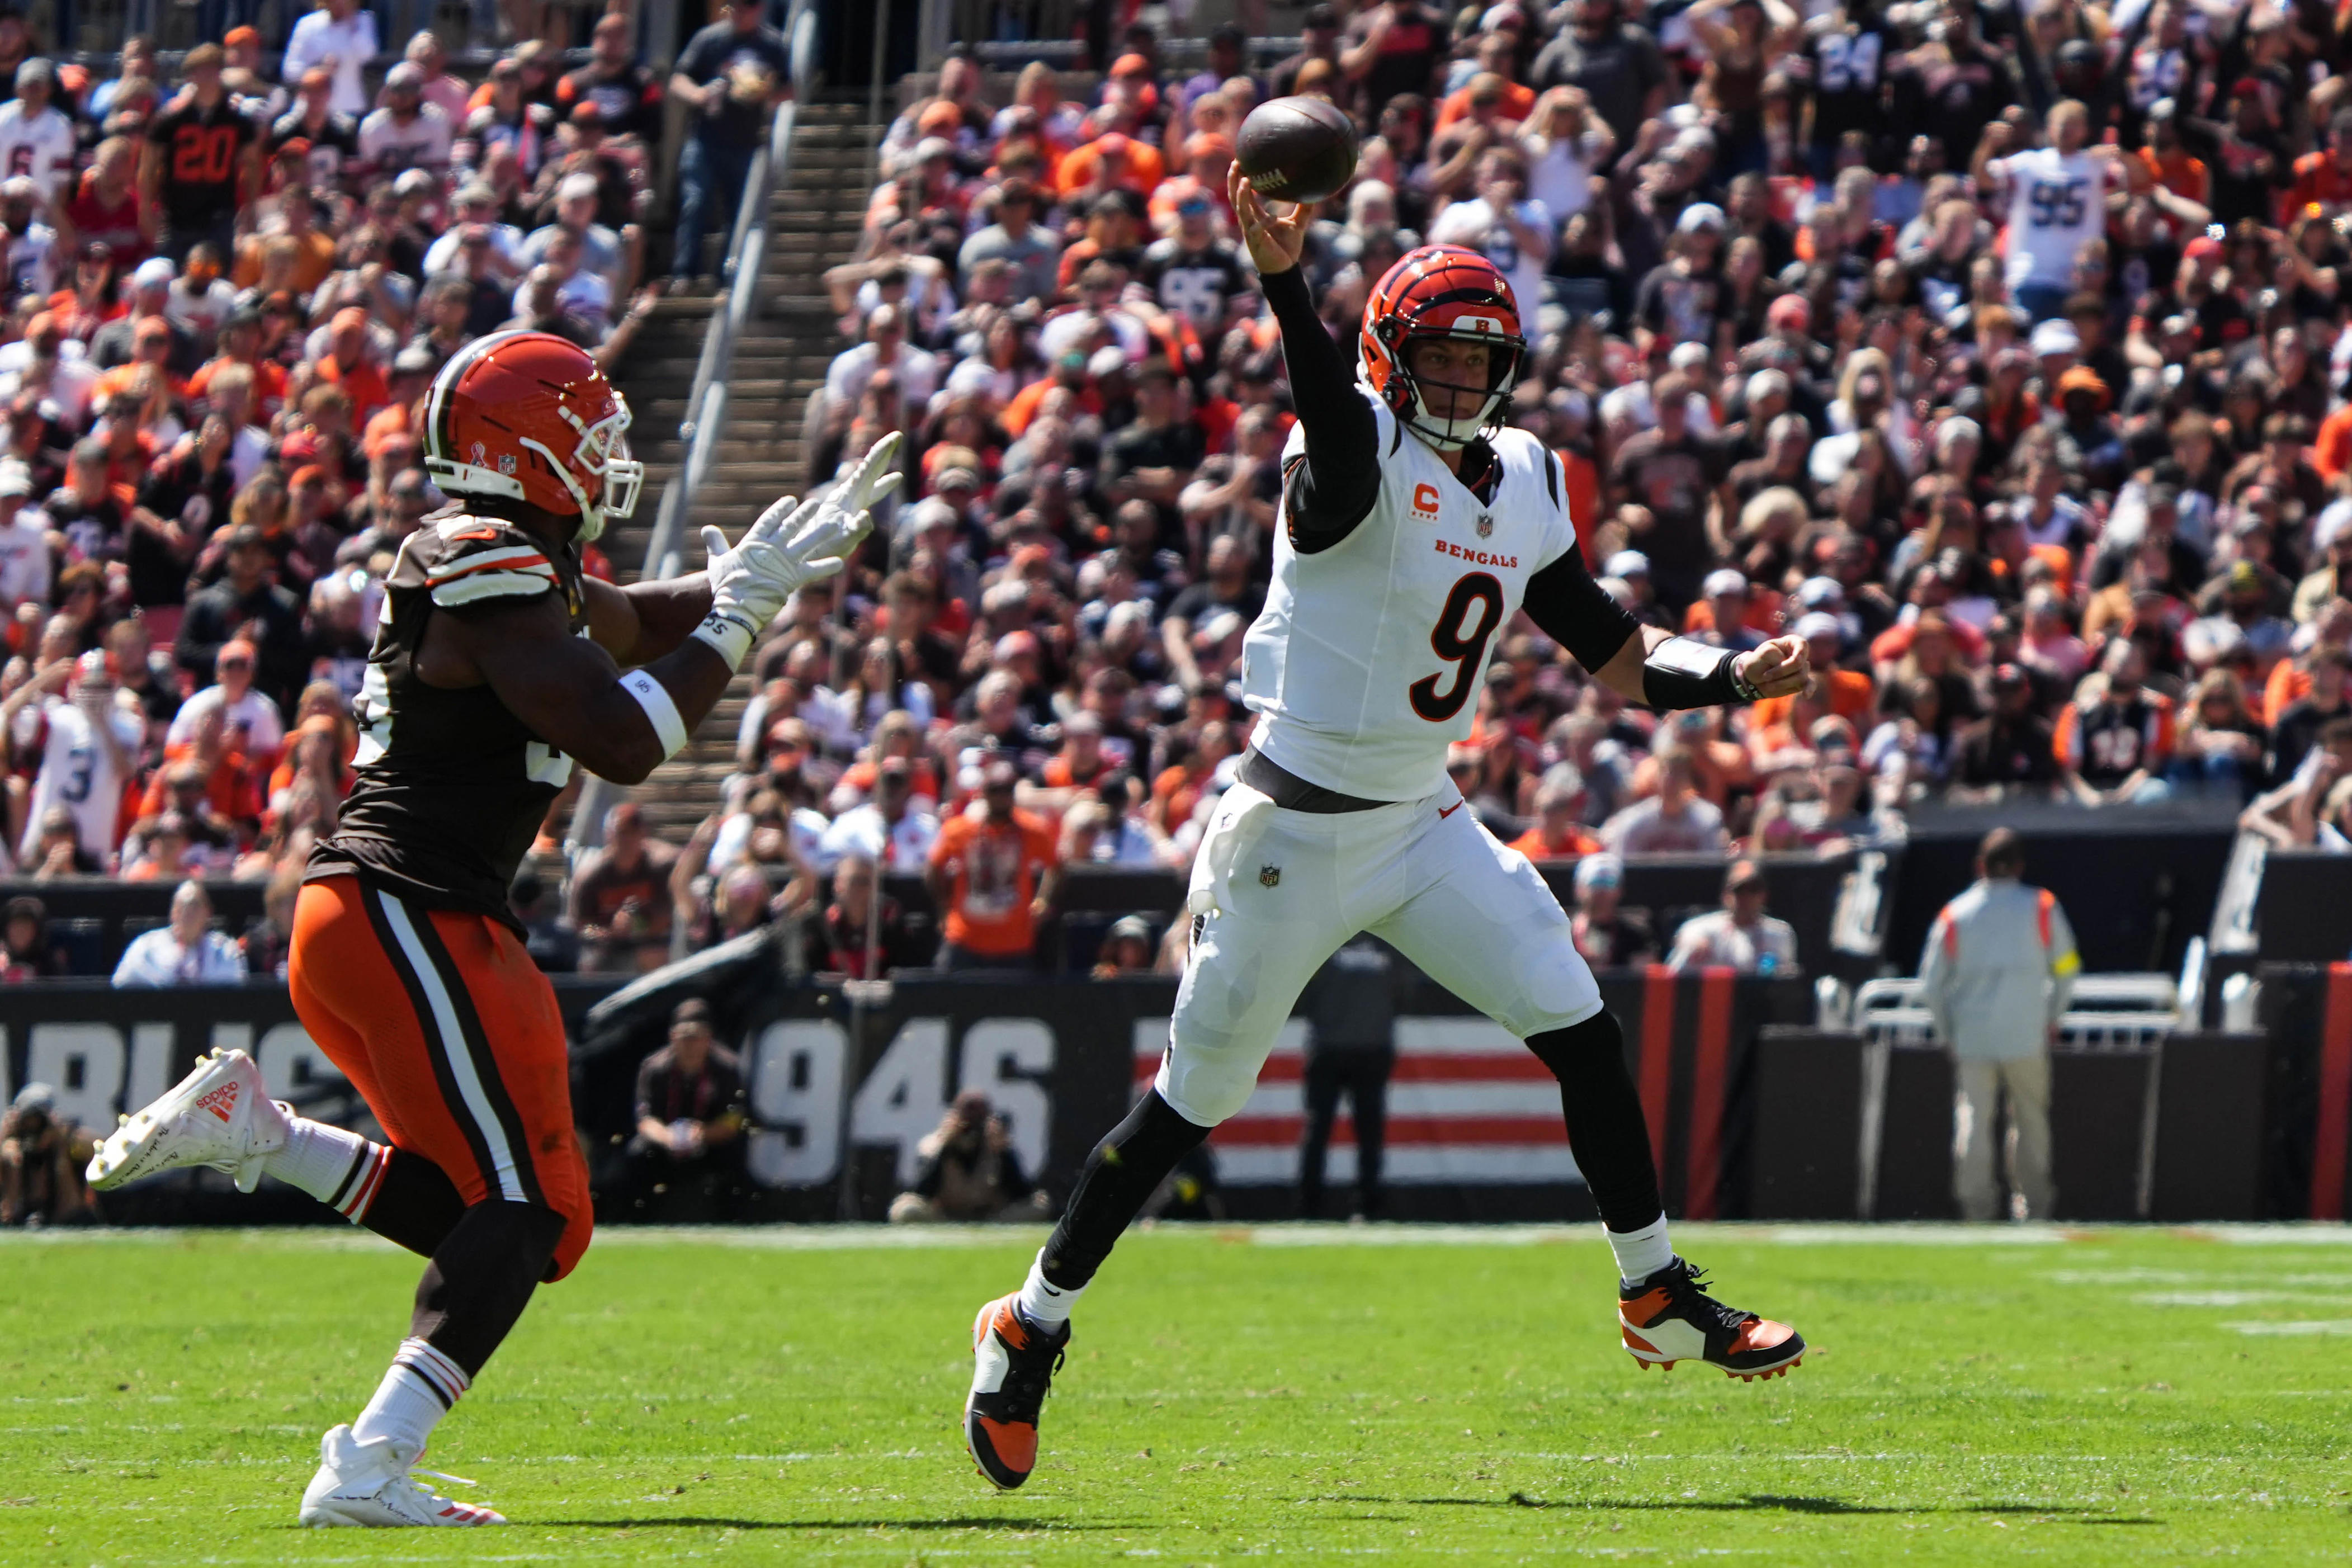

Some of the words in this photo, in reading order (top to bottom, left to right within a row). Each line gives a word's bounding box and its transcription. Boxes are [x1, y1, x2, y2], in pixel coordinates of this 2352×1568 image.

[173, 124, 239, 182] 20
[2030, 177, 2093, 227] 95
[1159, 267, 1226, 325] 95
[1414, 483, 1439, 513] C
[1435, 539, 1518, 568] BENGALS
[1409, 571, 1504, 722] 9
[60, 747, 96, 803] 3
[196, 1080, 239, 1109] adidas
[748, 1017, 1058, 1188] 946
